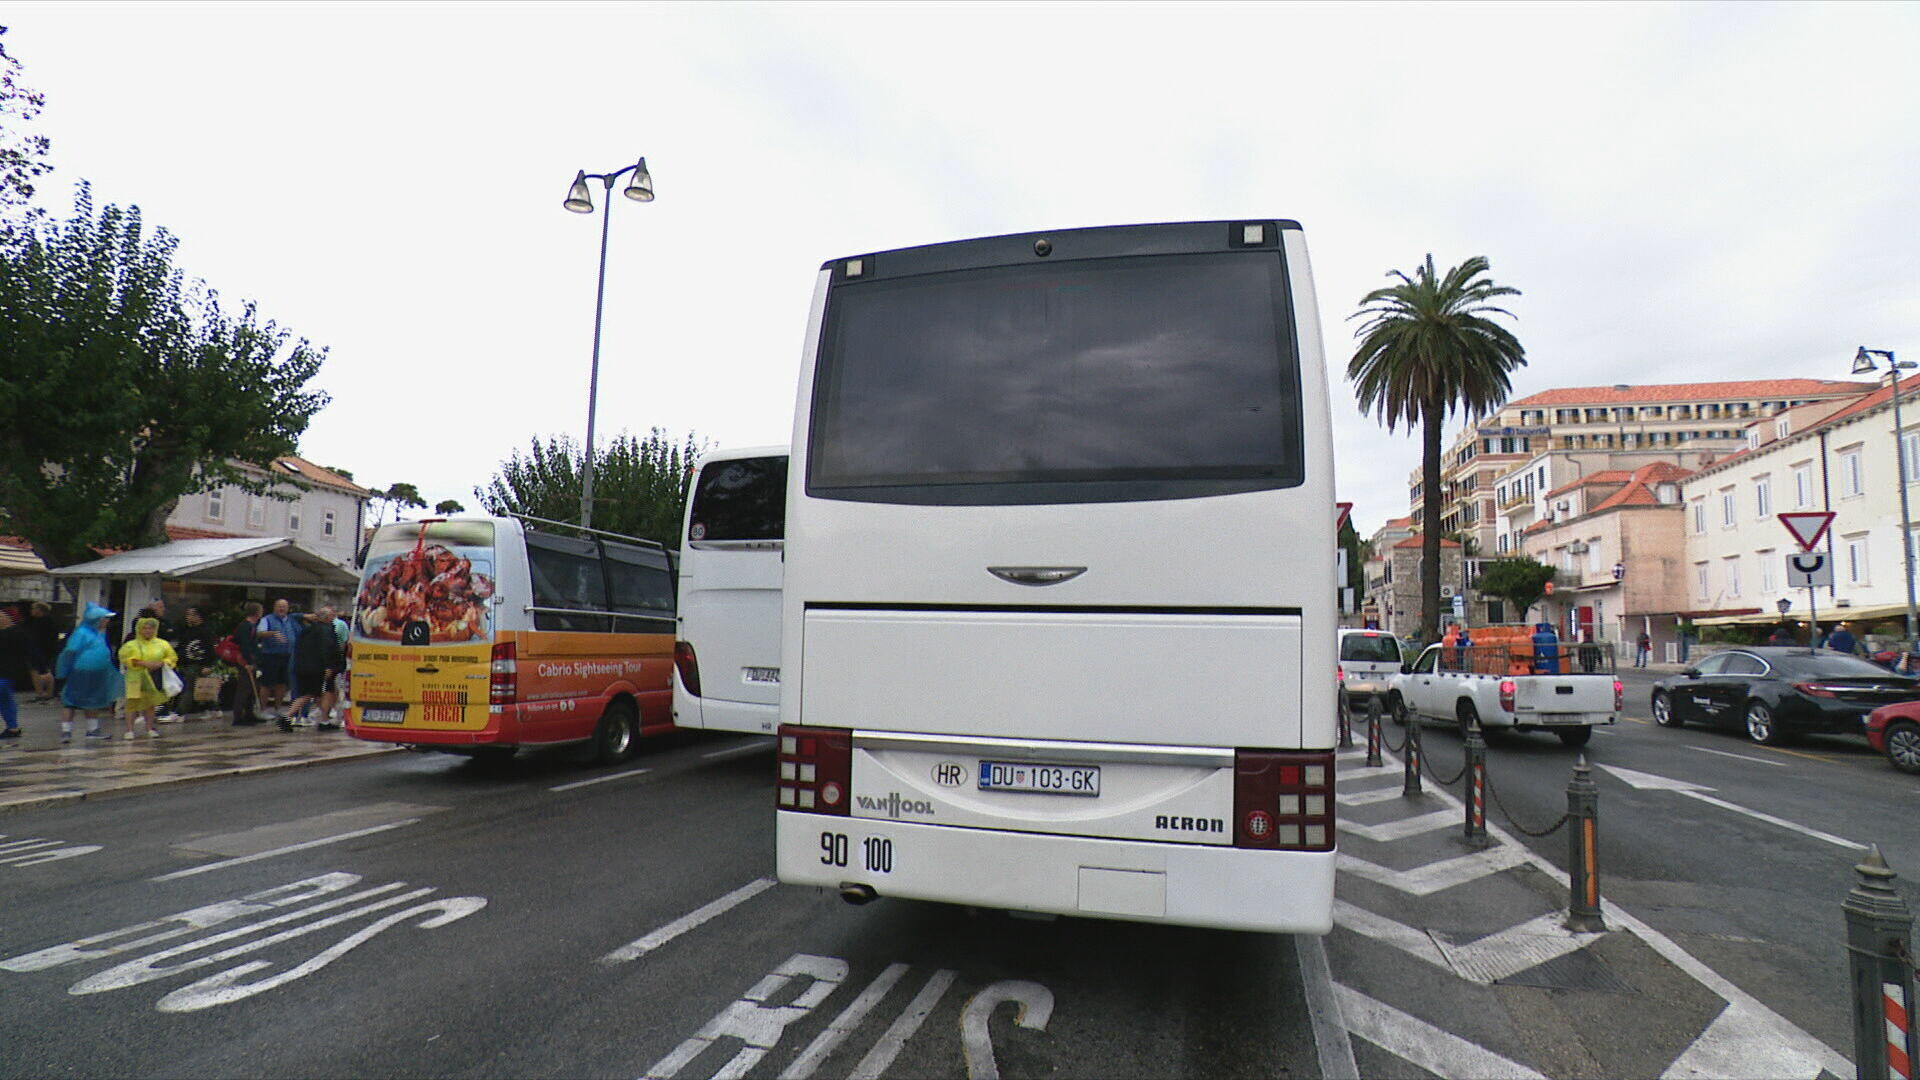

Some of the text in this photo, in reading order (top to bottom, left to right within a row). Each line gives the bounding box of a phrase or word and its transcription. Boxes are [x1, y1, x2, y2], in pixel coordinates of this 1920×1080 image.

[538, 660, 642, 679] Cabrio Sightseeing Tour
[938, 764, 961, 785] HR
[992, 766, 1094, 791] DU 103-GK
[1155, 815, 1224, 833] ACRON
[820, 831, 848, 868] 90
[863, 836, 893, 874] 100
[0, 871, 489, 1013] BUS
